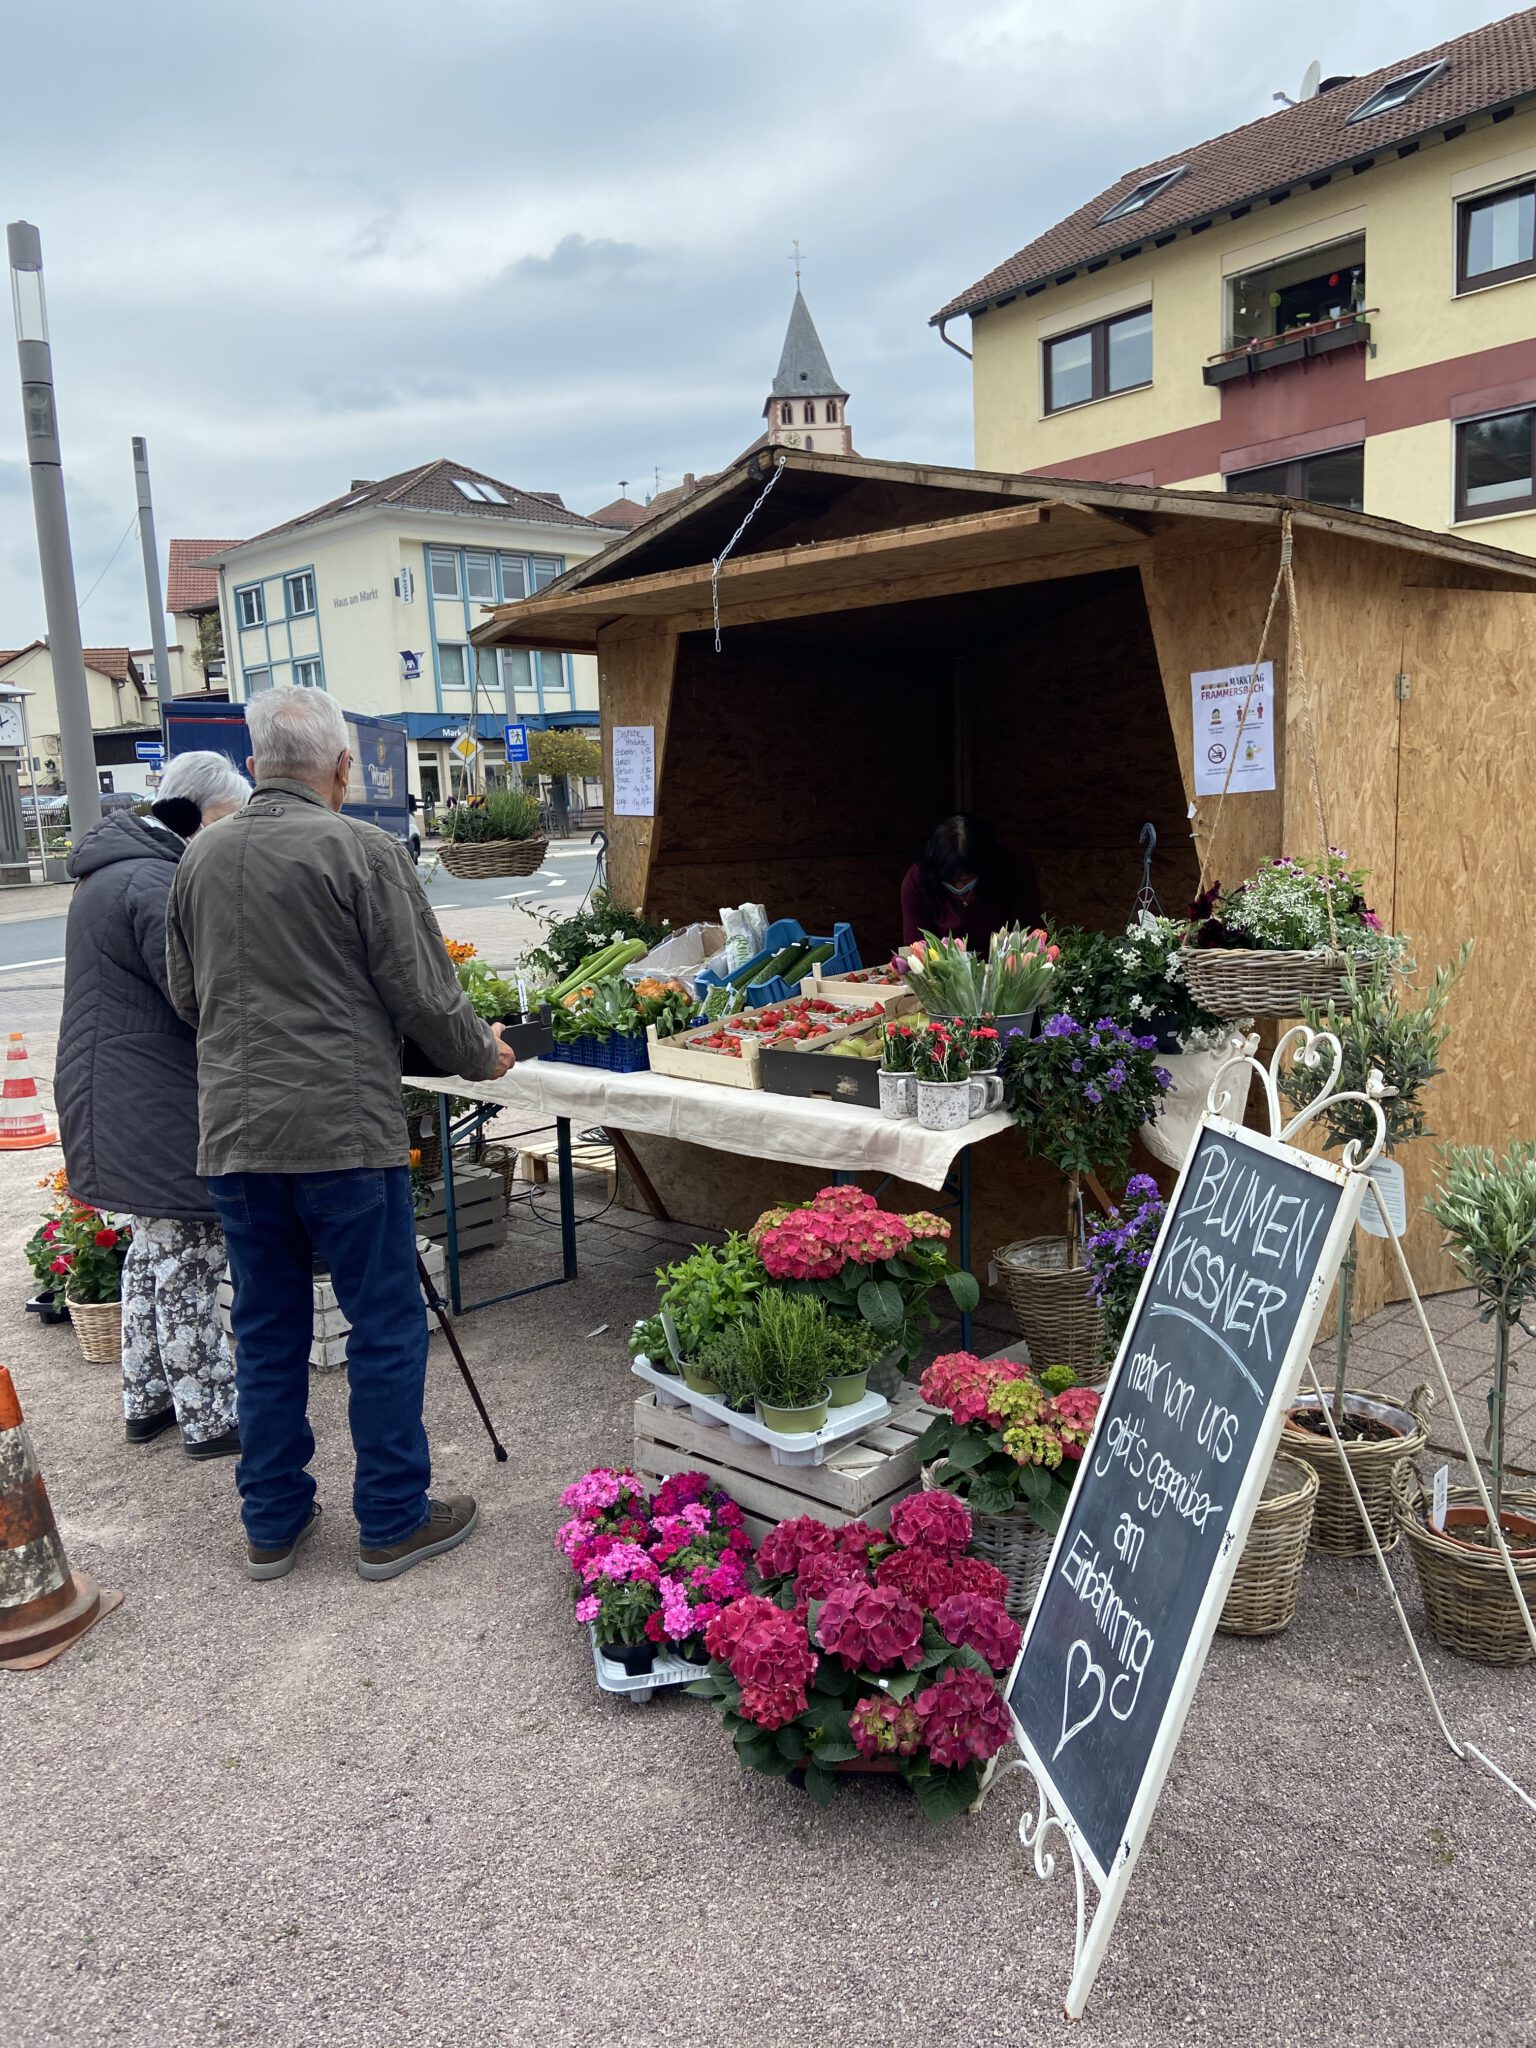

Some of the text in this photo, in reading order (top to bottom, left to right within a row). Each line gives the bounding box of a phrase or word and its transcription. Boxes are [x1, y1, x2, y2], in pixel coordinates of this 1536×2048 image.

[333, 588, 379, 608] Haus am Markt
[1201, 683, 1264, 700] FRAMMERSBCH
[1229, 673, 1264, 686] MARKTAG
[442, 728, 462, 737] Mark
[1178, 1144, 1325, 1279] BLUMEN
[1157, 1221, 1287, 1362] KISSNER
[1127, 1343, 1239, 1463] mehr von uns
[1138, 1469, 1224, 1535] gegenüber
[1114, 1512, 1145, 1573] am
